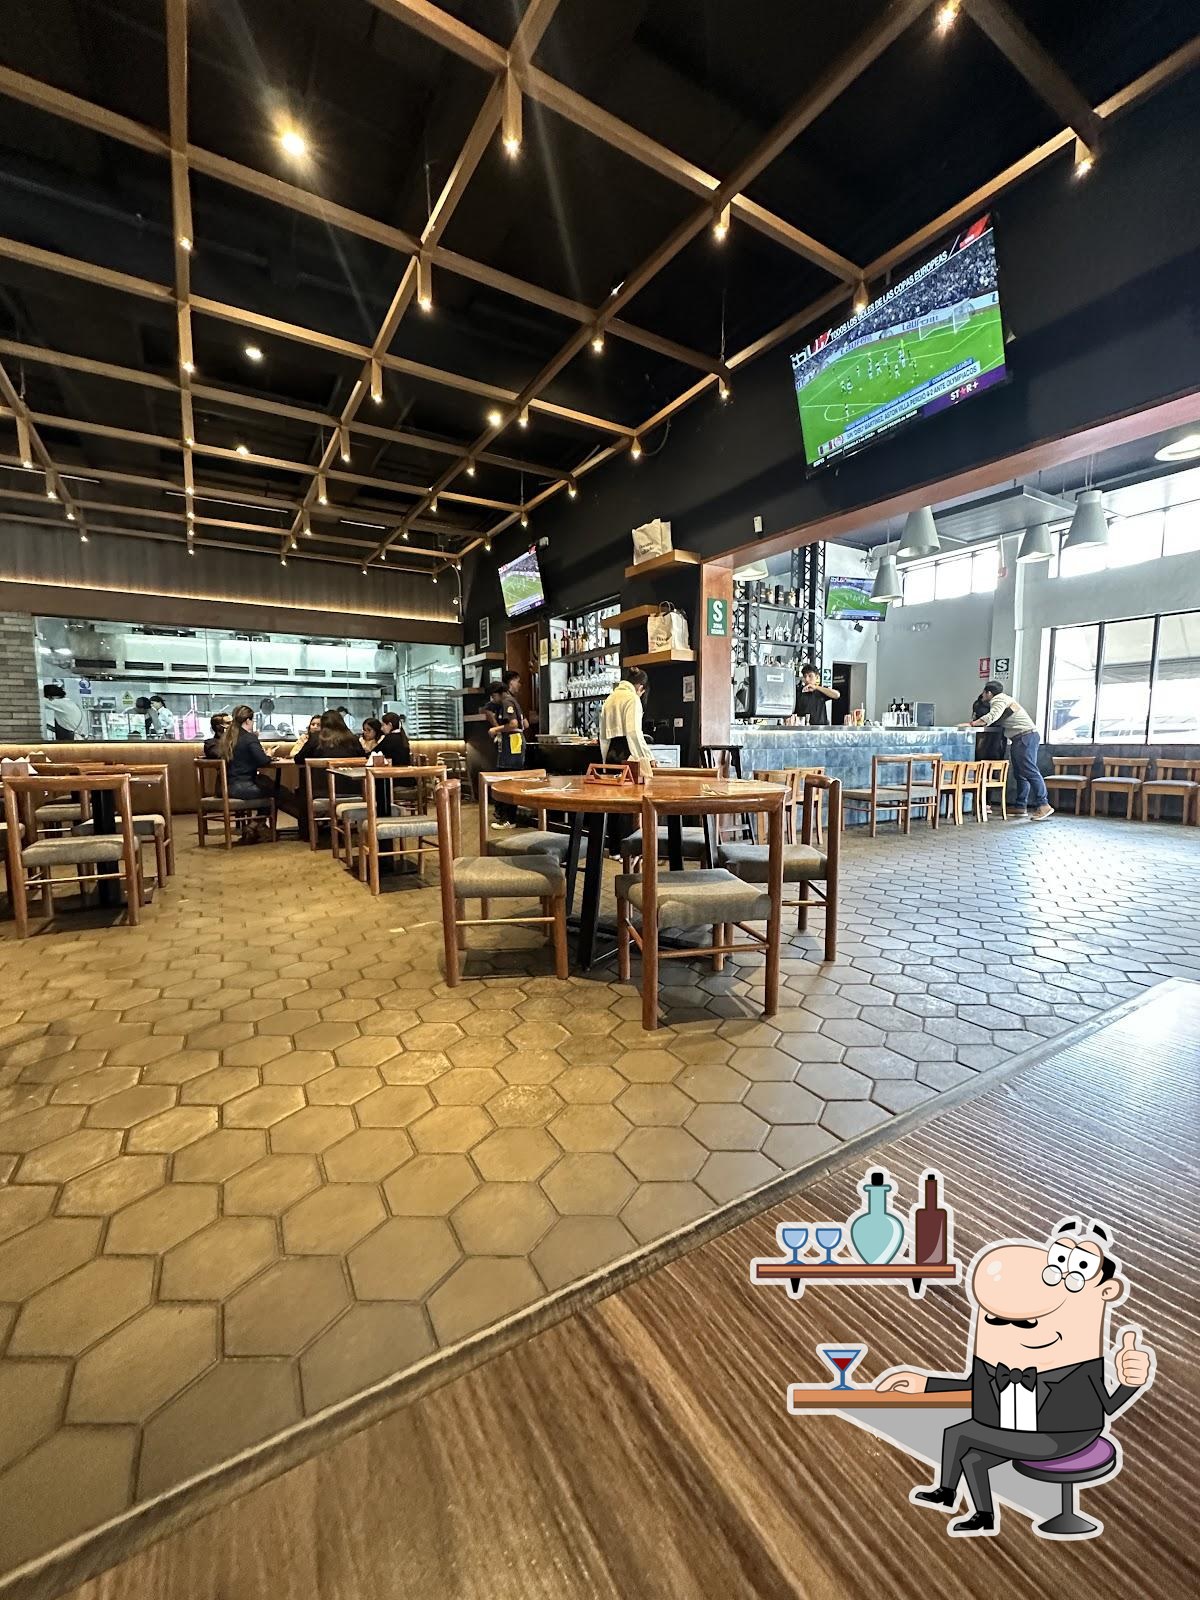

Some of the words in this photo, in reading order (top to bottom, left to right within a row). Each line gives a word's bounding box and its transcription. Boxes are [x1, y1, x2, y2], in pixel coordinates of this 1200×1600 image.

[831, 323, 848, 340] TODOS
[847, 316, 857, 328] LOS
[857, 303, 875, 320] GOLES
[875, 297, 883, 308] DE
[883, 290, 894, 302] LAS
[894, 275, 914, 296] COPAS
[914, 251, 948, 280] EUROPEAS
[933, 381, 946, 394] ANTE
[946, 365, 978, 387] OLYMPIACOS
[713, 600, 723, 622] S
[997, 660, 1008, 671] S
